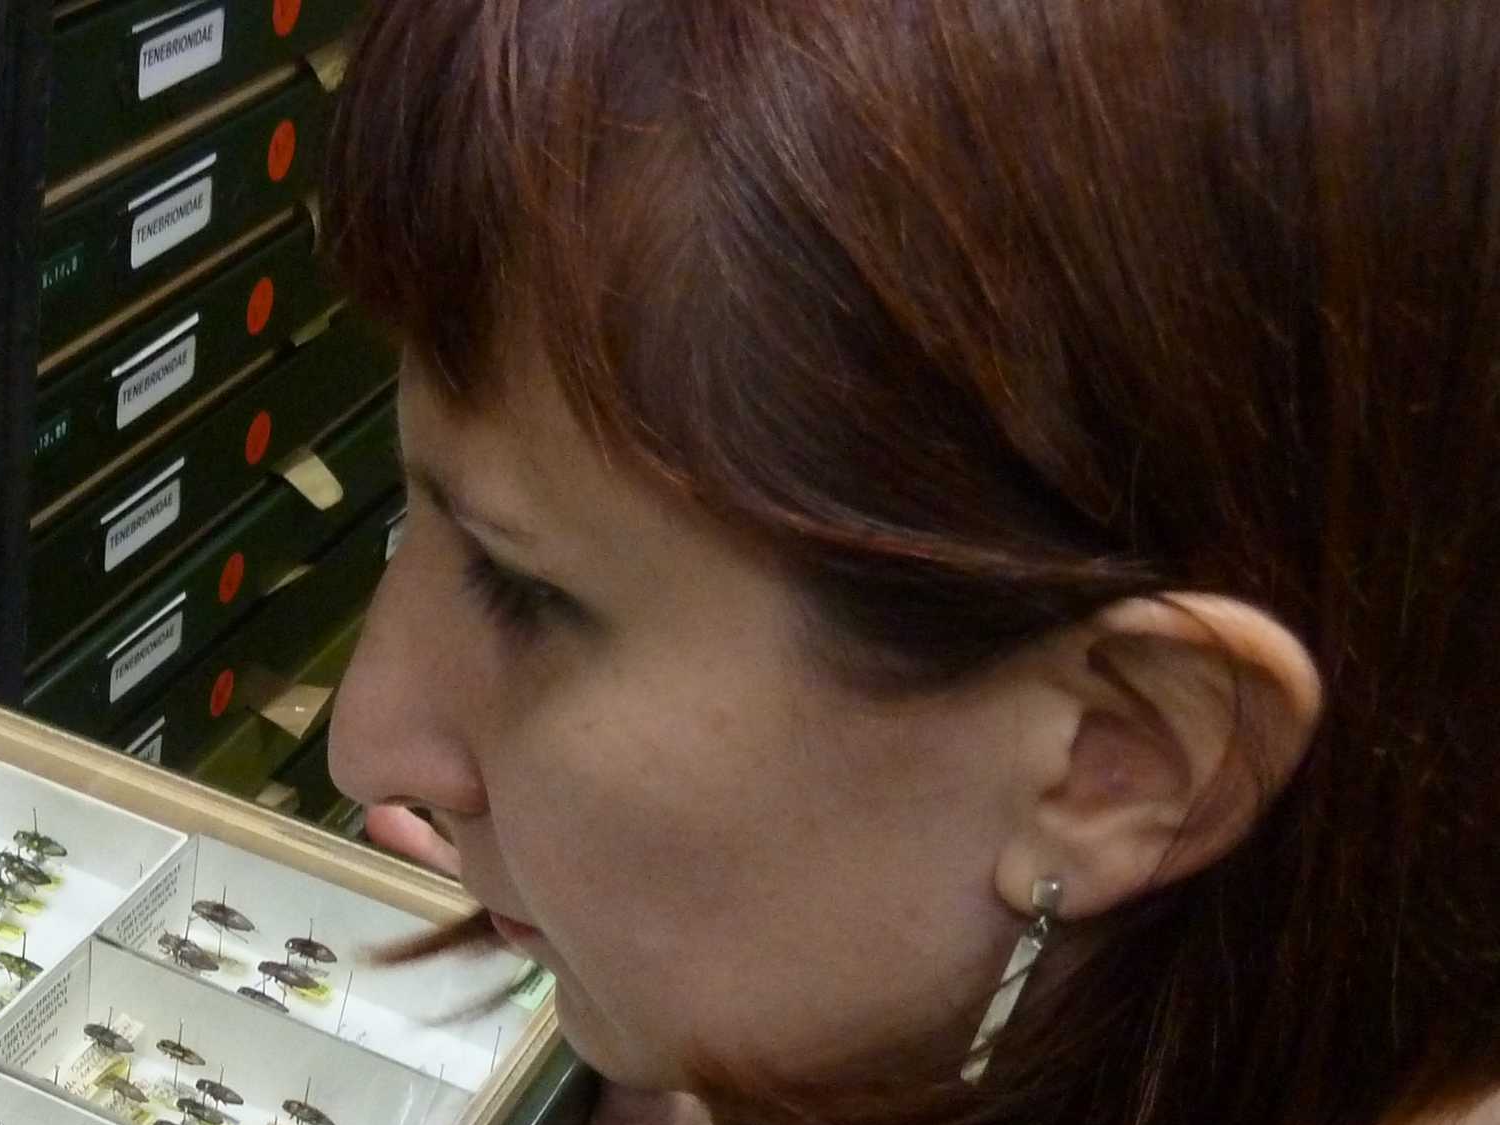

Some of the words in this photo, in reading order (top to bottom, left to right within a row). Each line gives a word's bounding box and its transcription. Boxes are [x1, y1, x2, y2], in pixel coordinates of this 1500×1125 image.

[143, 24, 213, 68] TENEBRIONIDAE
[136, 197, 203, 244] TENEBRIONIDAE
[122, 352, 188, 404] TENEBRIONIDAE
[109, 492, 173, 548] TENEBRIONIDAE
